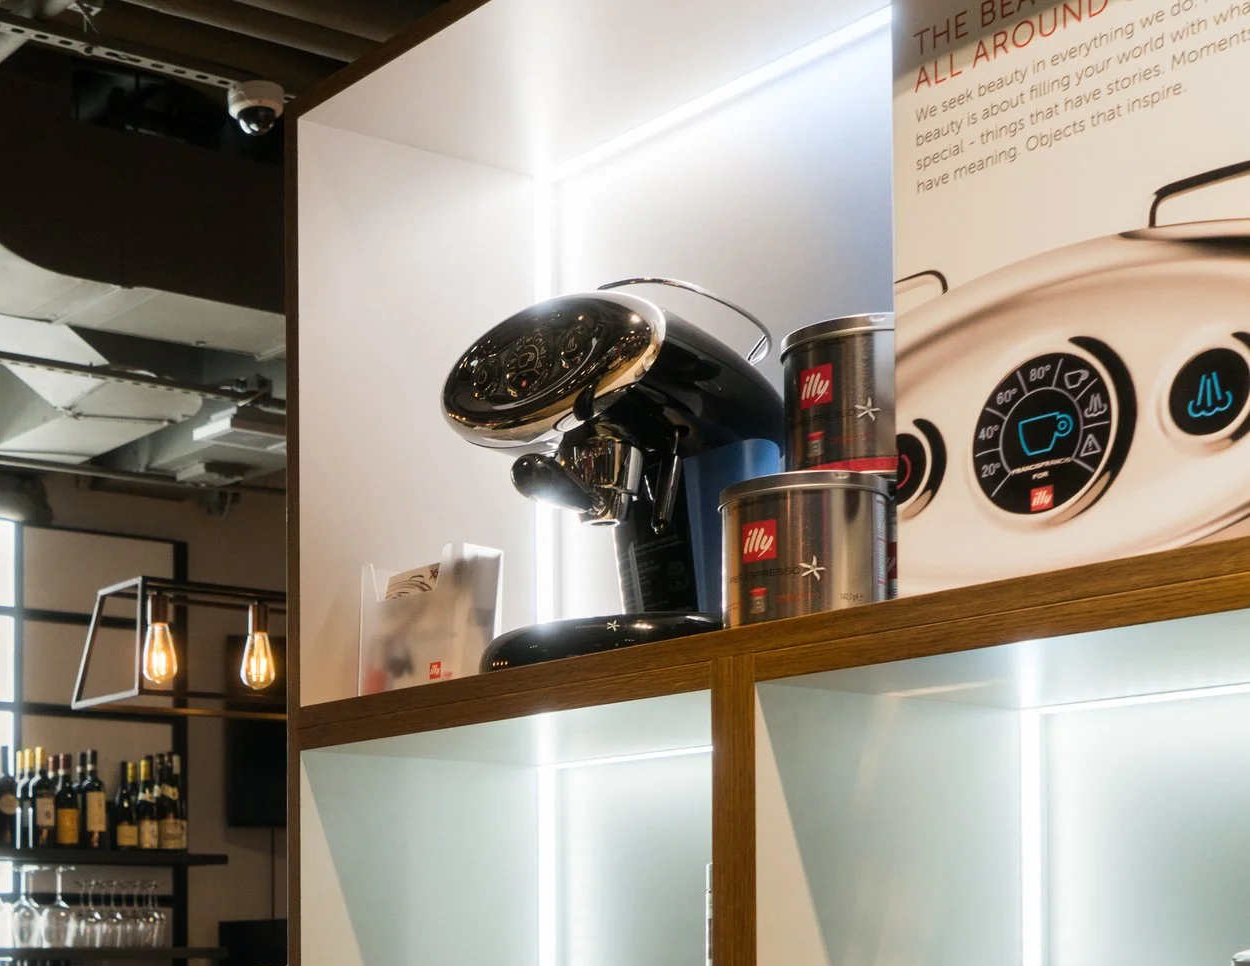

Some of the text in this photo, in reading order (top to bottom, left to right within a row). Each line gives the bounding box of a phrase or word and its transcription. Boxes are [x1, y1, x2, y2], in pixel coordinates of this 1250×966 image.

[913, 10, 968, 55] THE
[914, 52, 962, 93] ALL
[915, 104, 938, 123] We
[941, 88, 974, 113] seek
[977, 66, 1028, 98] beauty
[1032, 59, 1046, 75] in
[1050, 21, 1135, 67] everything
[1139, 9, 1166, 30] we
[915, 118, 964, 147] beauty
[966, 111, 978, 126] is
[981, 92, 1026, 121] about
[1029, 74, 1071, 101] filling
[1075, 56, 1112, 87] your
[1117, 34, 1165, 65] world
[1170, 17, 1207, 43] with
[915, 139, 964, 171] special
[980, 117, 1025, 146] things
[1030, 104, 1060, 126] that
[1064, 88, 1101, 113] have
[1106, 63, 1165, 96] stories.
[916, 81, 1187, 194] have meaning. Objects that inspire.
[802, 372, 830, 402] illy
[1031, 490, 1053, 506] illy
[744, 528, 774, 557] illy
